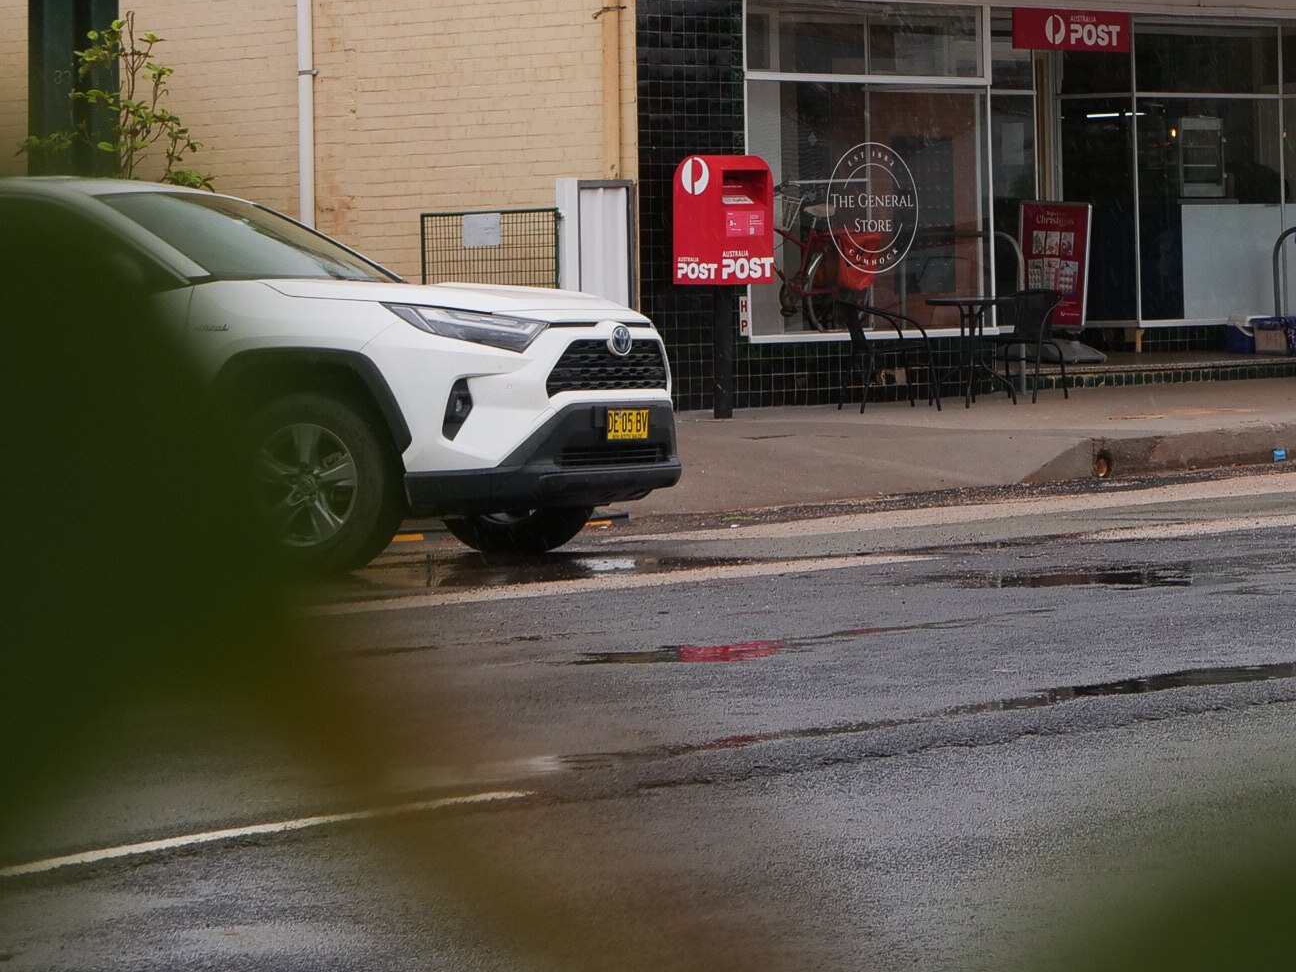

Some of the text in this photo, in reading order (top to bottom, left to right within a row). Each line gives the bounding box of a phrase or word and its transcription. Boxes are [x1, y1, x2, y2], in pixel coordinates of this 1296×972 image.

[1070, 15, 1097, 23] AUSTRALIA
[1070, 23, 1121, 46] POST
[848, 150, 895, 167] EST 1882
[830, 193, 914, 208] THE GENERAL
[854, 218, 893, 233] STORE
[848, 247, 899, 266] CUMNOCK
[677, 262, 718, 280] POST
[722, 257, 774, 280] POST
